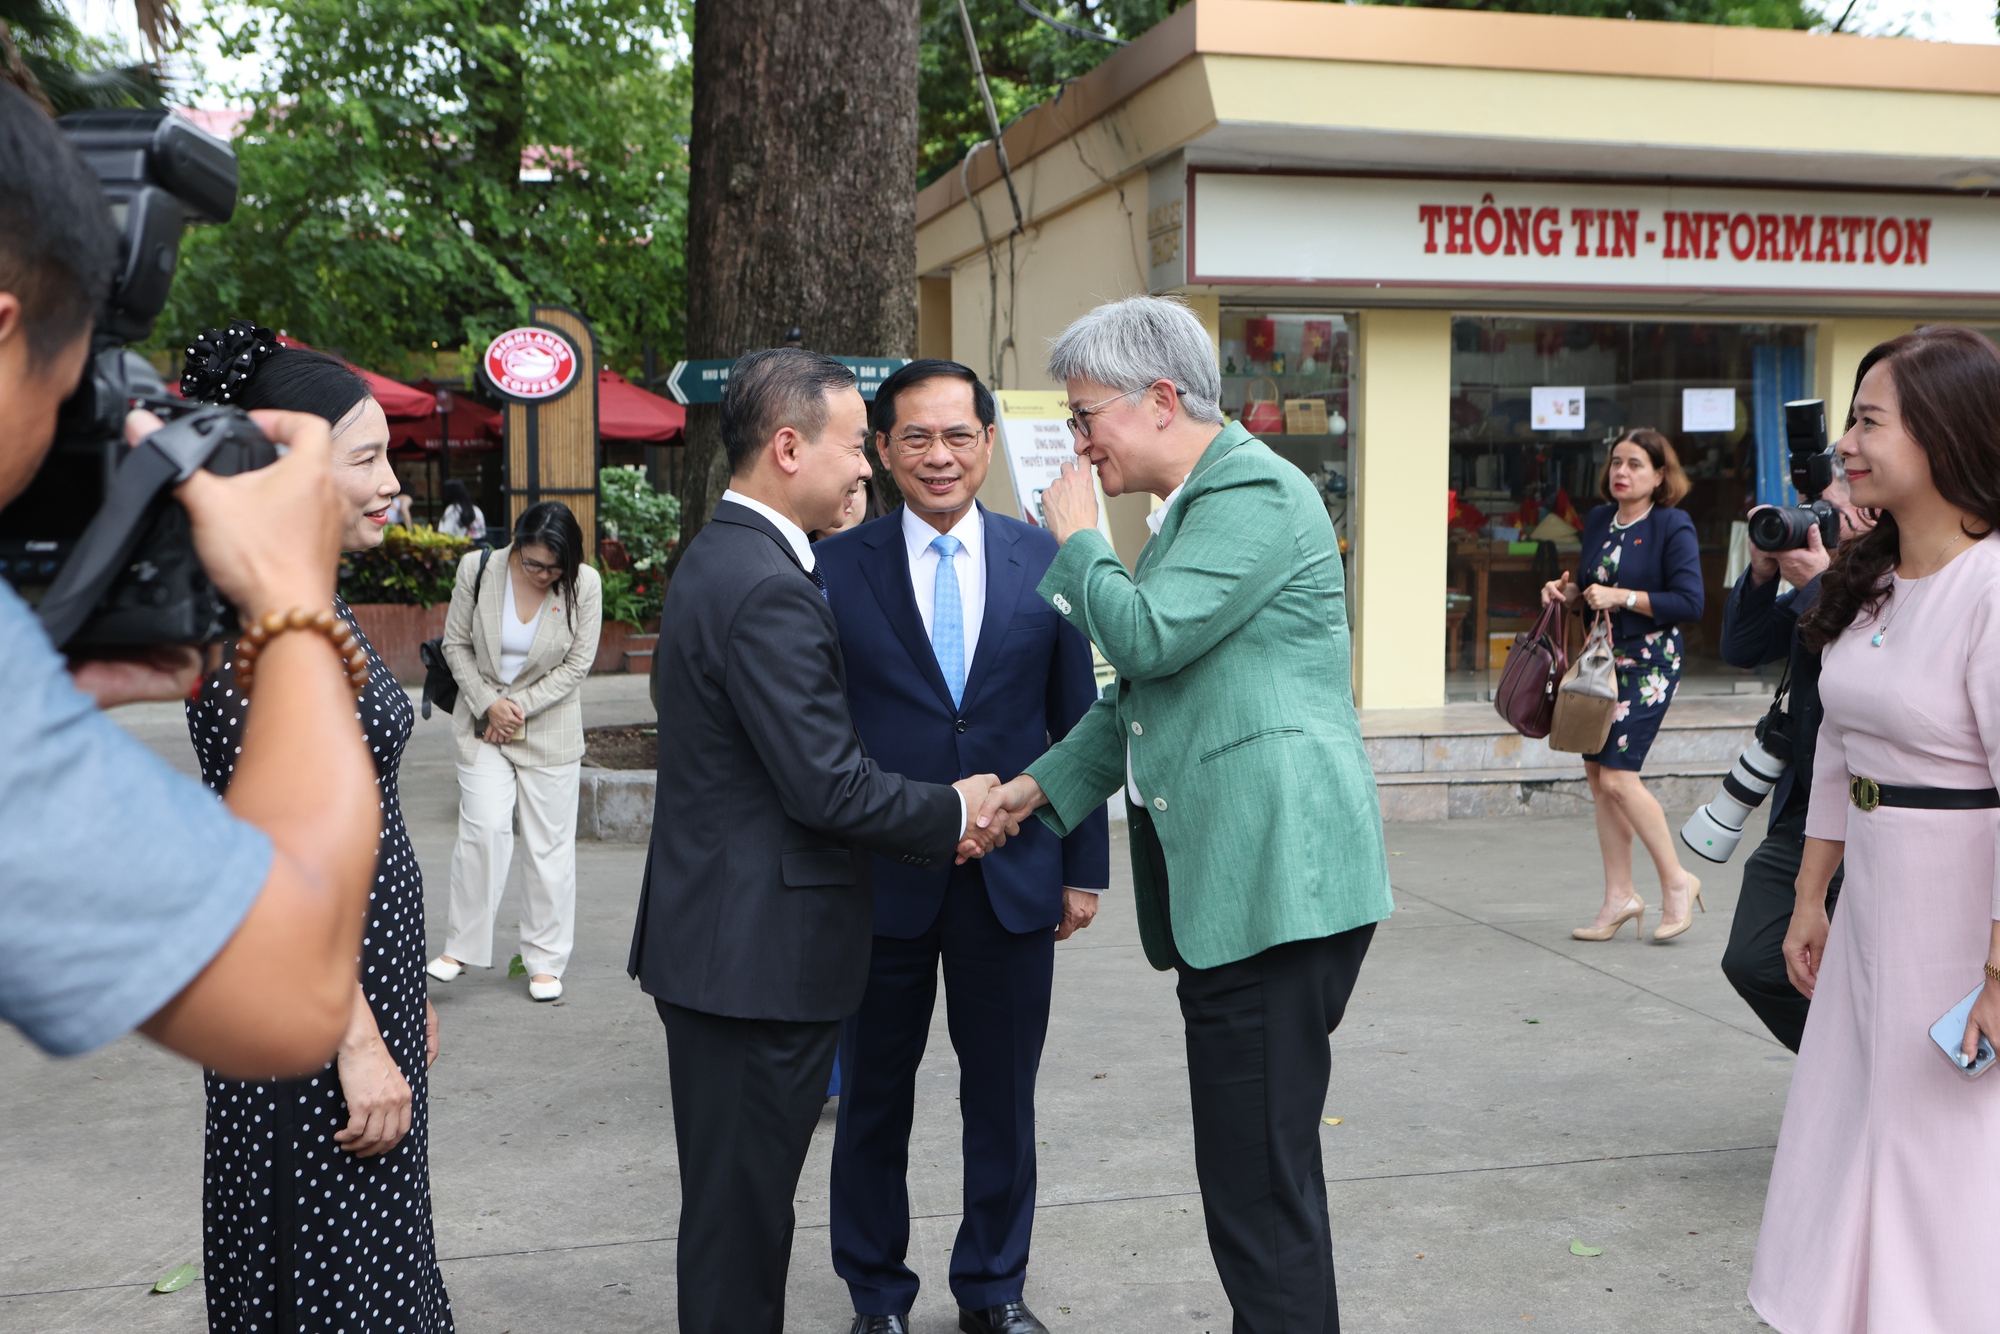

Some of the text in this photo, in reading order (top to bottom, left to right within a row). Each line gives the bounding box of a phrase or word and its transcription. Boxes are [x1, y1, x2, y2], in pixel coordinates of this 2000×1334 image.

[1419, 192, 1562, 256] THÔNG
[1571, 208, 1639, 258] TIN
[1663, 211, 1931, 265] INFORMATION
[492, 332, 569, 361] HIGHLANDS
[702, 368, 718, 381] KHU
[501, 375, 560, 393] COFFEE
[1021, 453, 1044, 467] THUYẾT
[1044, 456, 1060, 466] MINH
